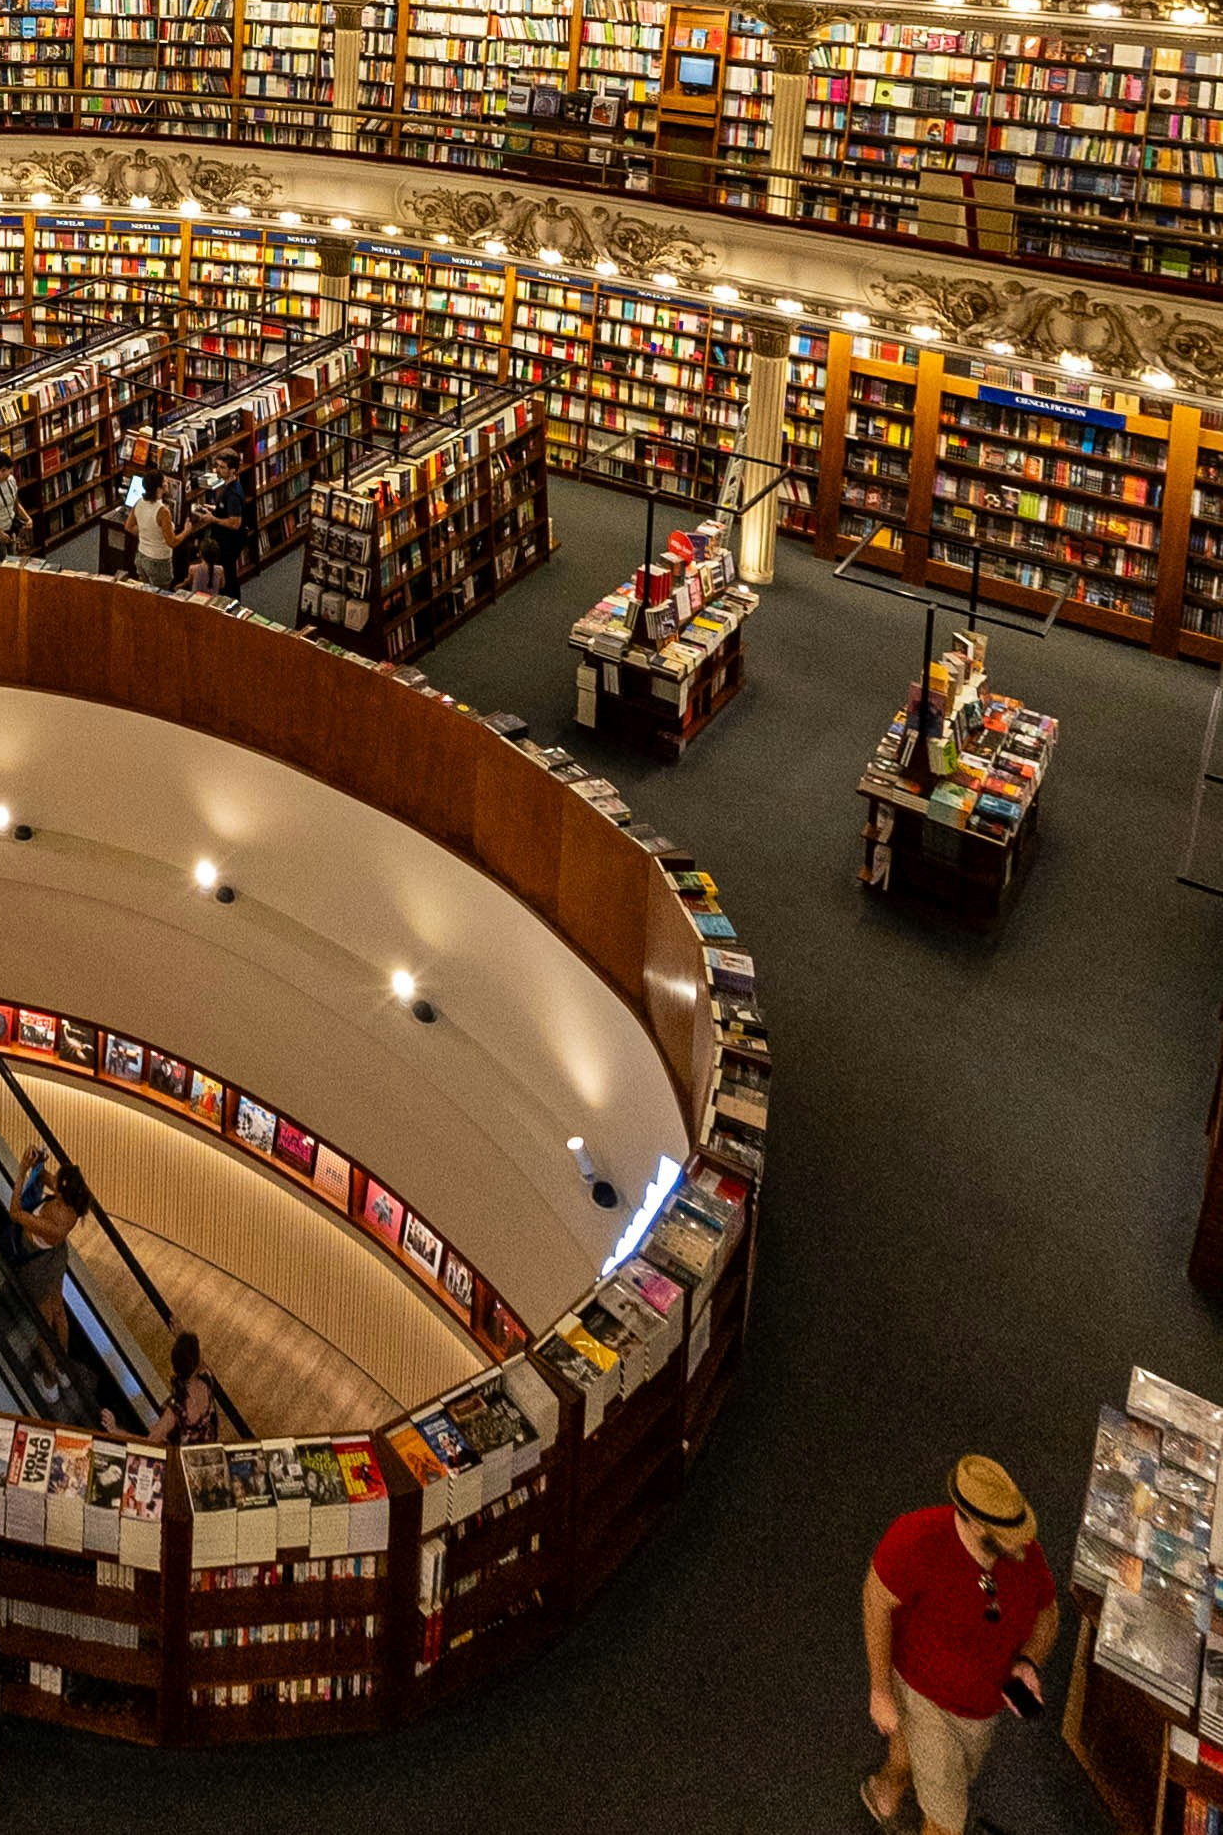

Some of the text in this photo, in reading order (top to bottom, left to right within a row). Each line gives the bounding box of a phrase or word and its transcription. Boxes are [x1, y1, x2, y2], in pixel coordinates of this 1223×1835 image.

[211, 228, 241, 237] NOVELAS
[287, 236, 317, 244] NOVELAS
[371, 246, 401, 256] NOVELAS
[451, 257, 483, 266] NOVELAS
[538, 272, 569, 282] NOVELAS
[1015, 396, 1050, 409] CIENCIA
[22, 1436, 40, 1482] HOLA
[33, 1438, 51, 1482] VINO
